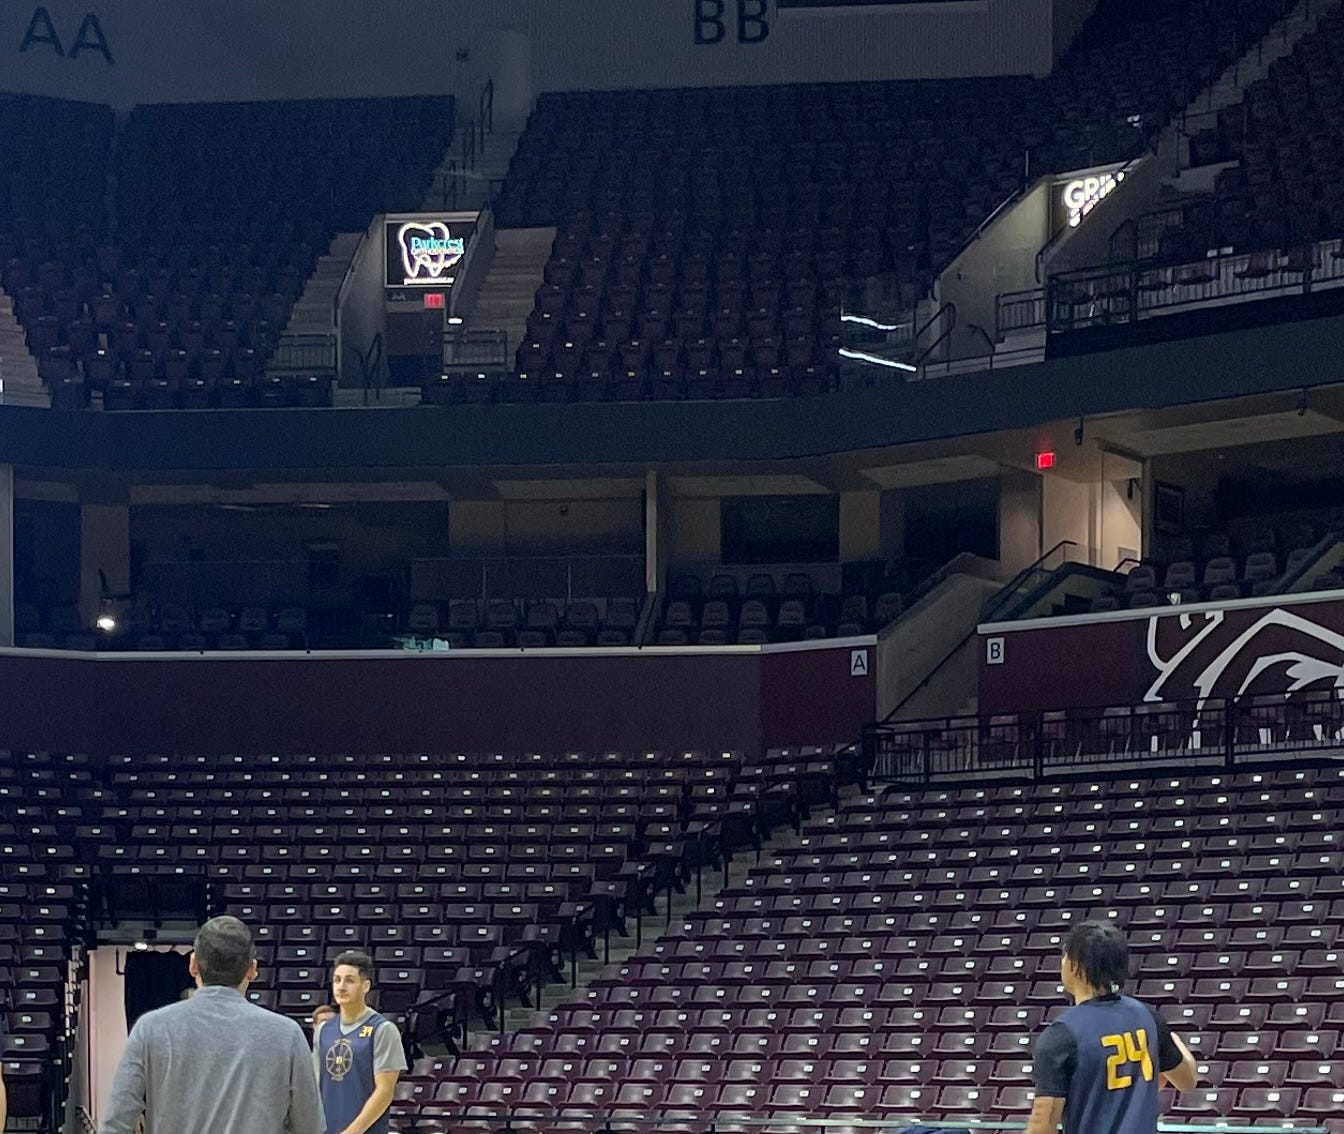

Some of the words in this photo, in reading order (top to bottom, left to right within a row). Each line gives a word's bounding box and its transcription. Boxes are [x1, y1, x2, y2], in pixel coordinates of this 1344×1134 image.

[18, 6, 115, 64] AA
[694, 0, 770, 44] BB
[852, 655, 866, 671] A
[990, 642, 1001, 660] B
[1100, 1028, 1154, 1090] 24
